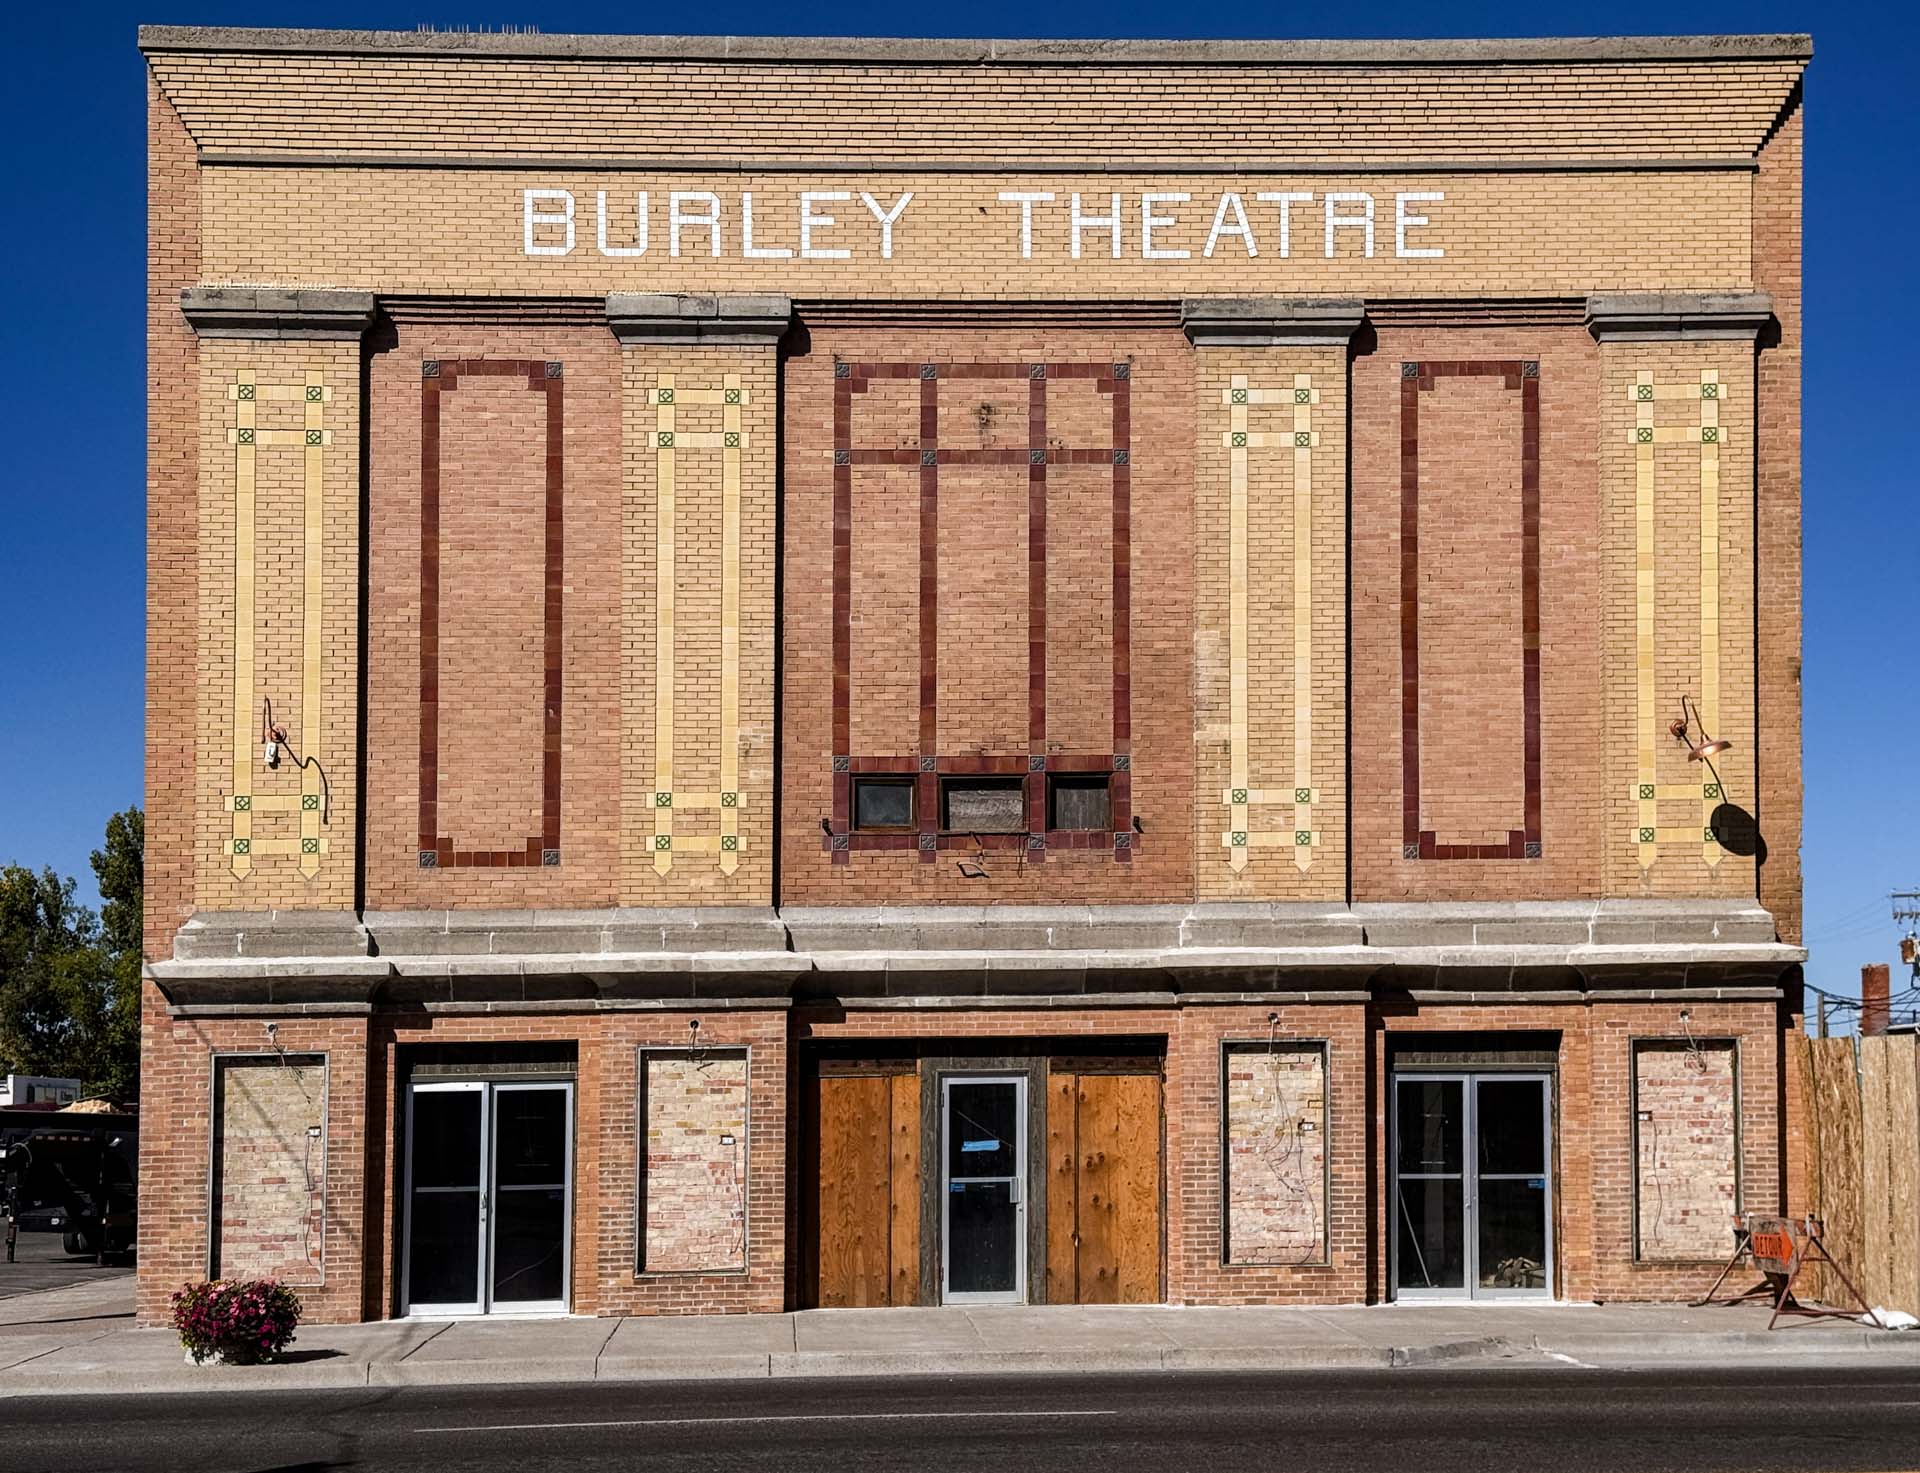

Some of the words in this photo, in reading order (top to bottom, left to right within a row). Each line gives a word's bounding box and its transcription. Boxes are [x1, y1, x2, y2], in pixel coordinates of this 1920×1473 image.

[523, 189, 915, 259] BURLEY
[998, 191, 1446, 259] THEATRE
[1754, 1234, 1784, 1257] DETOUR
